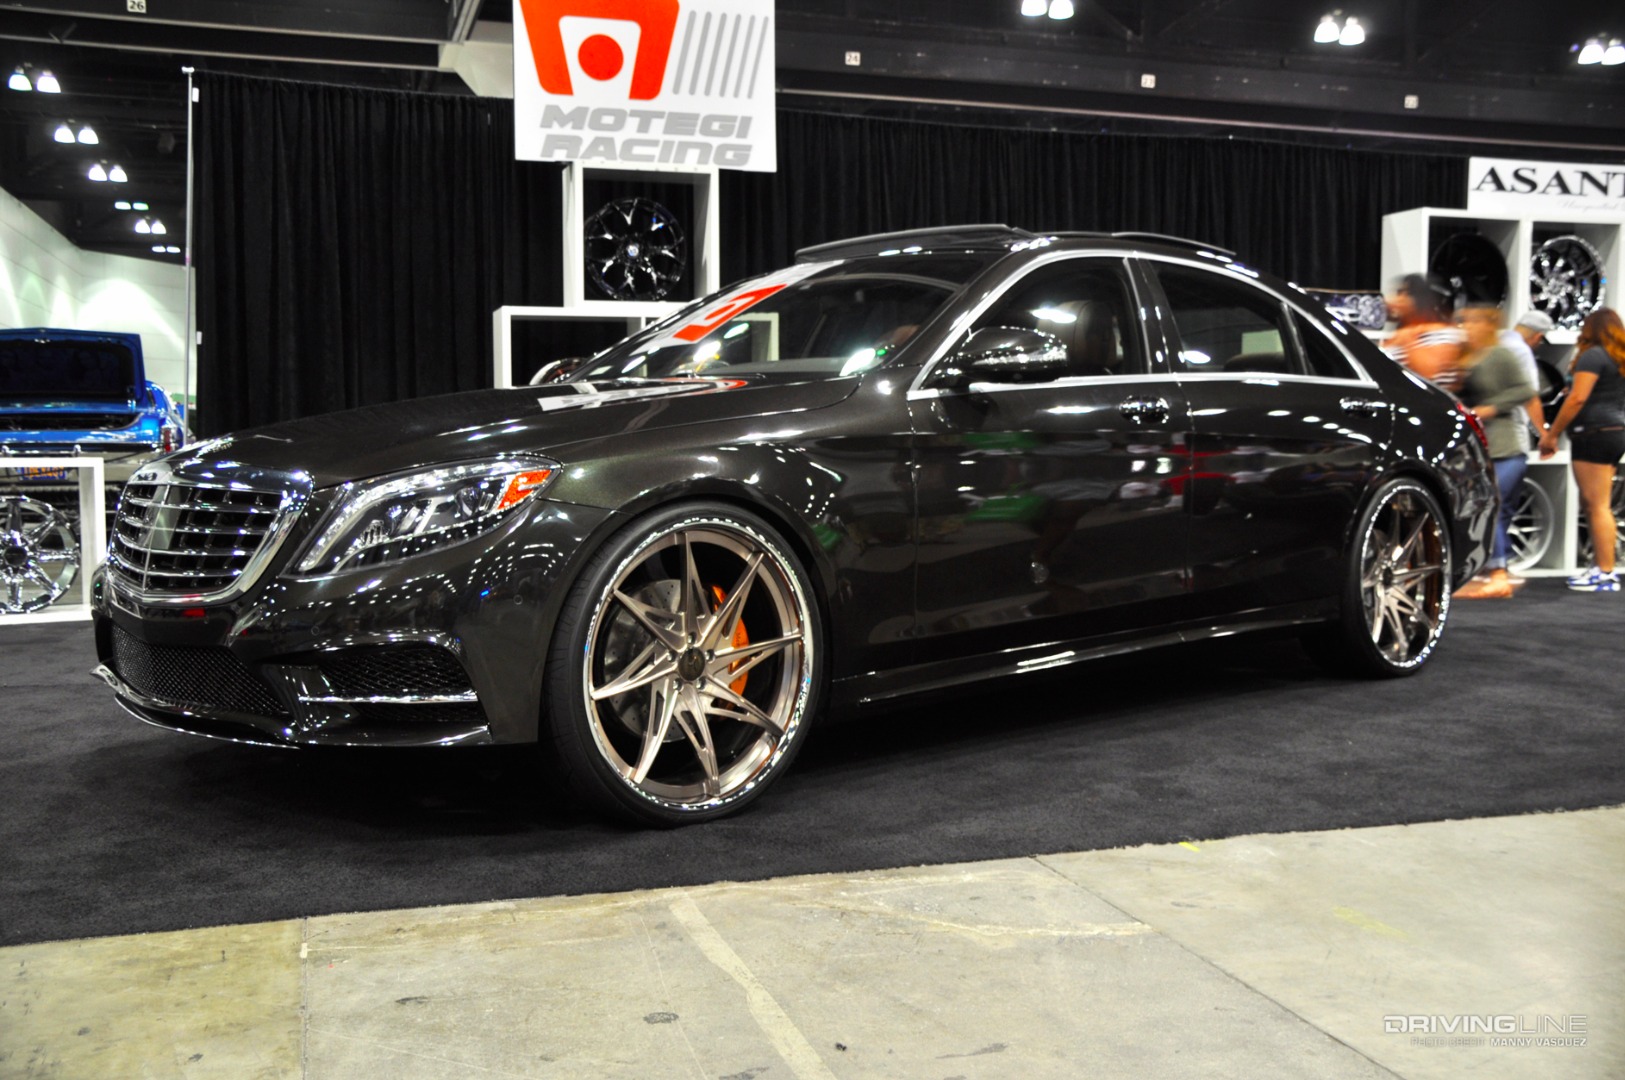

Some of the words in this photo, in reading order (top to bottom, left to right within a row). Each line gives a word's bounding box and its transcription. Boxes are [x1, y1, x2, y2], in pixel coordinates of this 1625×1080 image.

[129, 0, 145, 10] 26
[540, 104, 753, 139] MOTEGI
[540, 134, 753, 167] RACING
